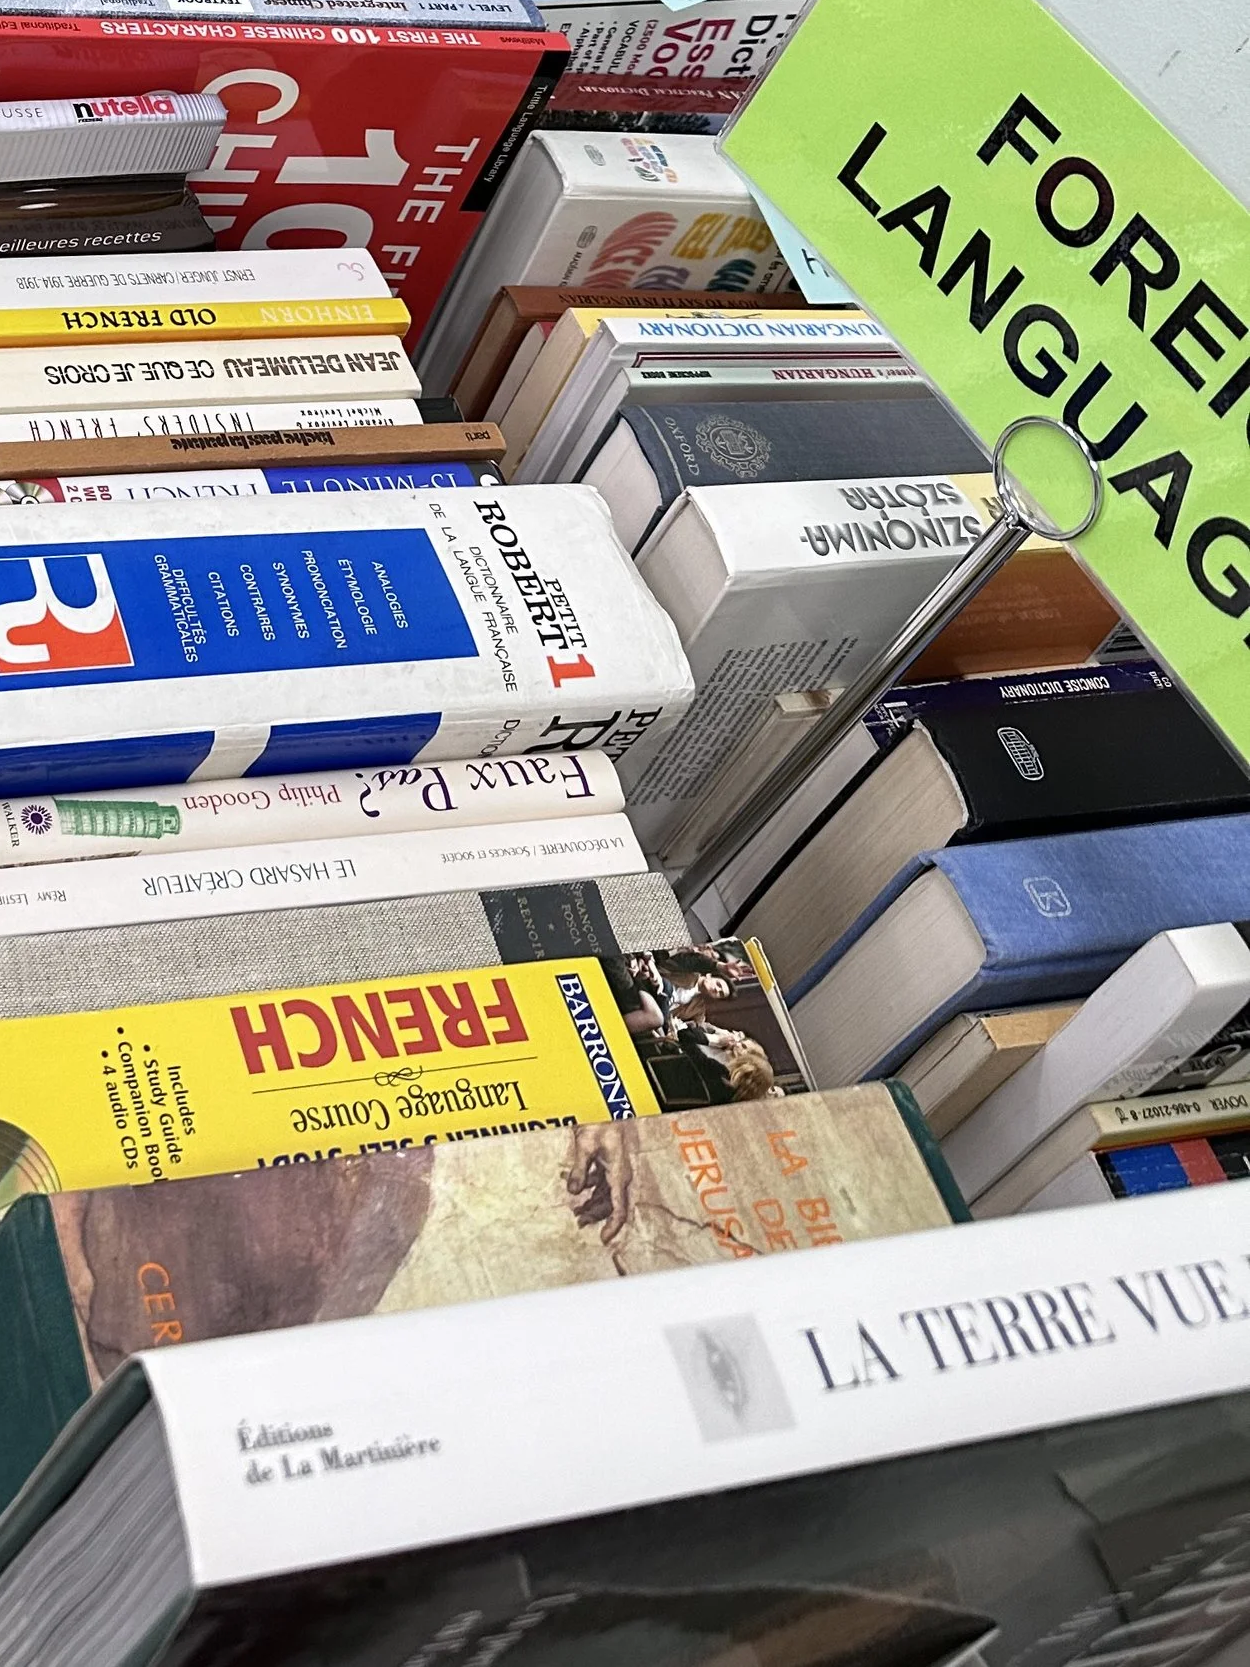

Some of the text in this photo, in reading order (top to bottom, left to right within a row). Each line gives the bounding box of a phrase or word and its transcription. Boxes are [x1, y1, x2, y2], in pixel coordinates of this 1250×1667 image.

[99, 20, 237, 38] CHARACTERS
[239, 23, 326, 41] CHINESE
[331, 28, 381, 46] 100
[385, 29, 437, 44] FIRST
[440, 32, 481, 45] THE
[72, 95, 175, 120] nutella
[84, 232, 162, 247] recettes
[977, 93, 1250, 429] FOREI
[60, 309, 163, 330] FRENCH
[168, 307, 217, 327] OLD
[44, 350, 402, 386] JEAN DELUMEAU CE QUE JE CROIS
[771, 367, 874, 381] HUNGARIAN
[837, 122, 1250, 629] LANGUAG
[664, 416, 701, 476] OXFORD
[208, 571, 239, 636] CITATIONS
[272, 562, 310, 639] SYNONYMES
[371, 561, 409, 629] ANALOGIES
[473, 499, 596, 688] ROBERT 1
[543, 578, 587, 649] PETIT
[998, 674, 1110, 700] CONCISE DICTIONARY
[181, 755, 594, 818] Faux Pas? Philip Gooden
[141, 858, 358, 896] LE HASARD CRÉATEUR
[229, 976, 530, 1076] FRENCH
[289, 1079, 530, 1138] Language Course
[1129, 1093, 1249, 1120] DOVER 0-486-21027-8
[799, 1262, 1236, 1395] LA TERRE VUE
[236, 1417, 335, 1453] Éditions
[244, 1431, 443, 1485] de La Martinière
